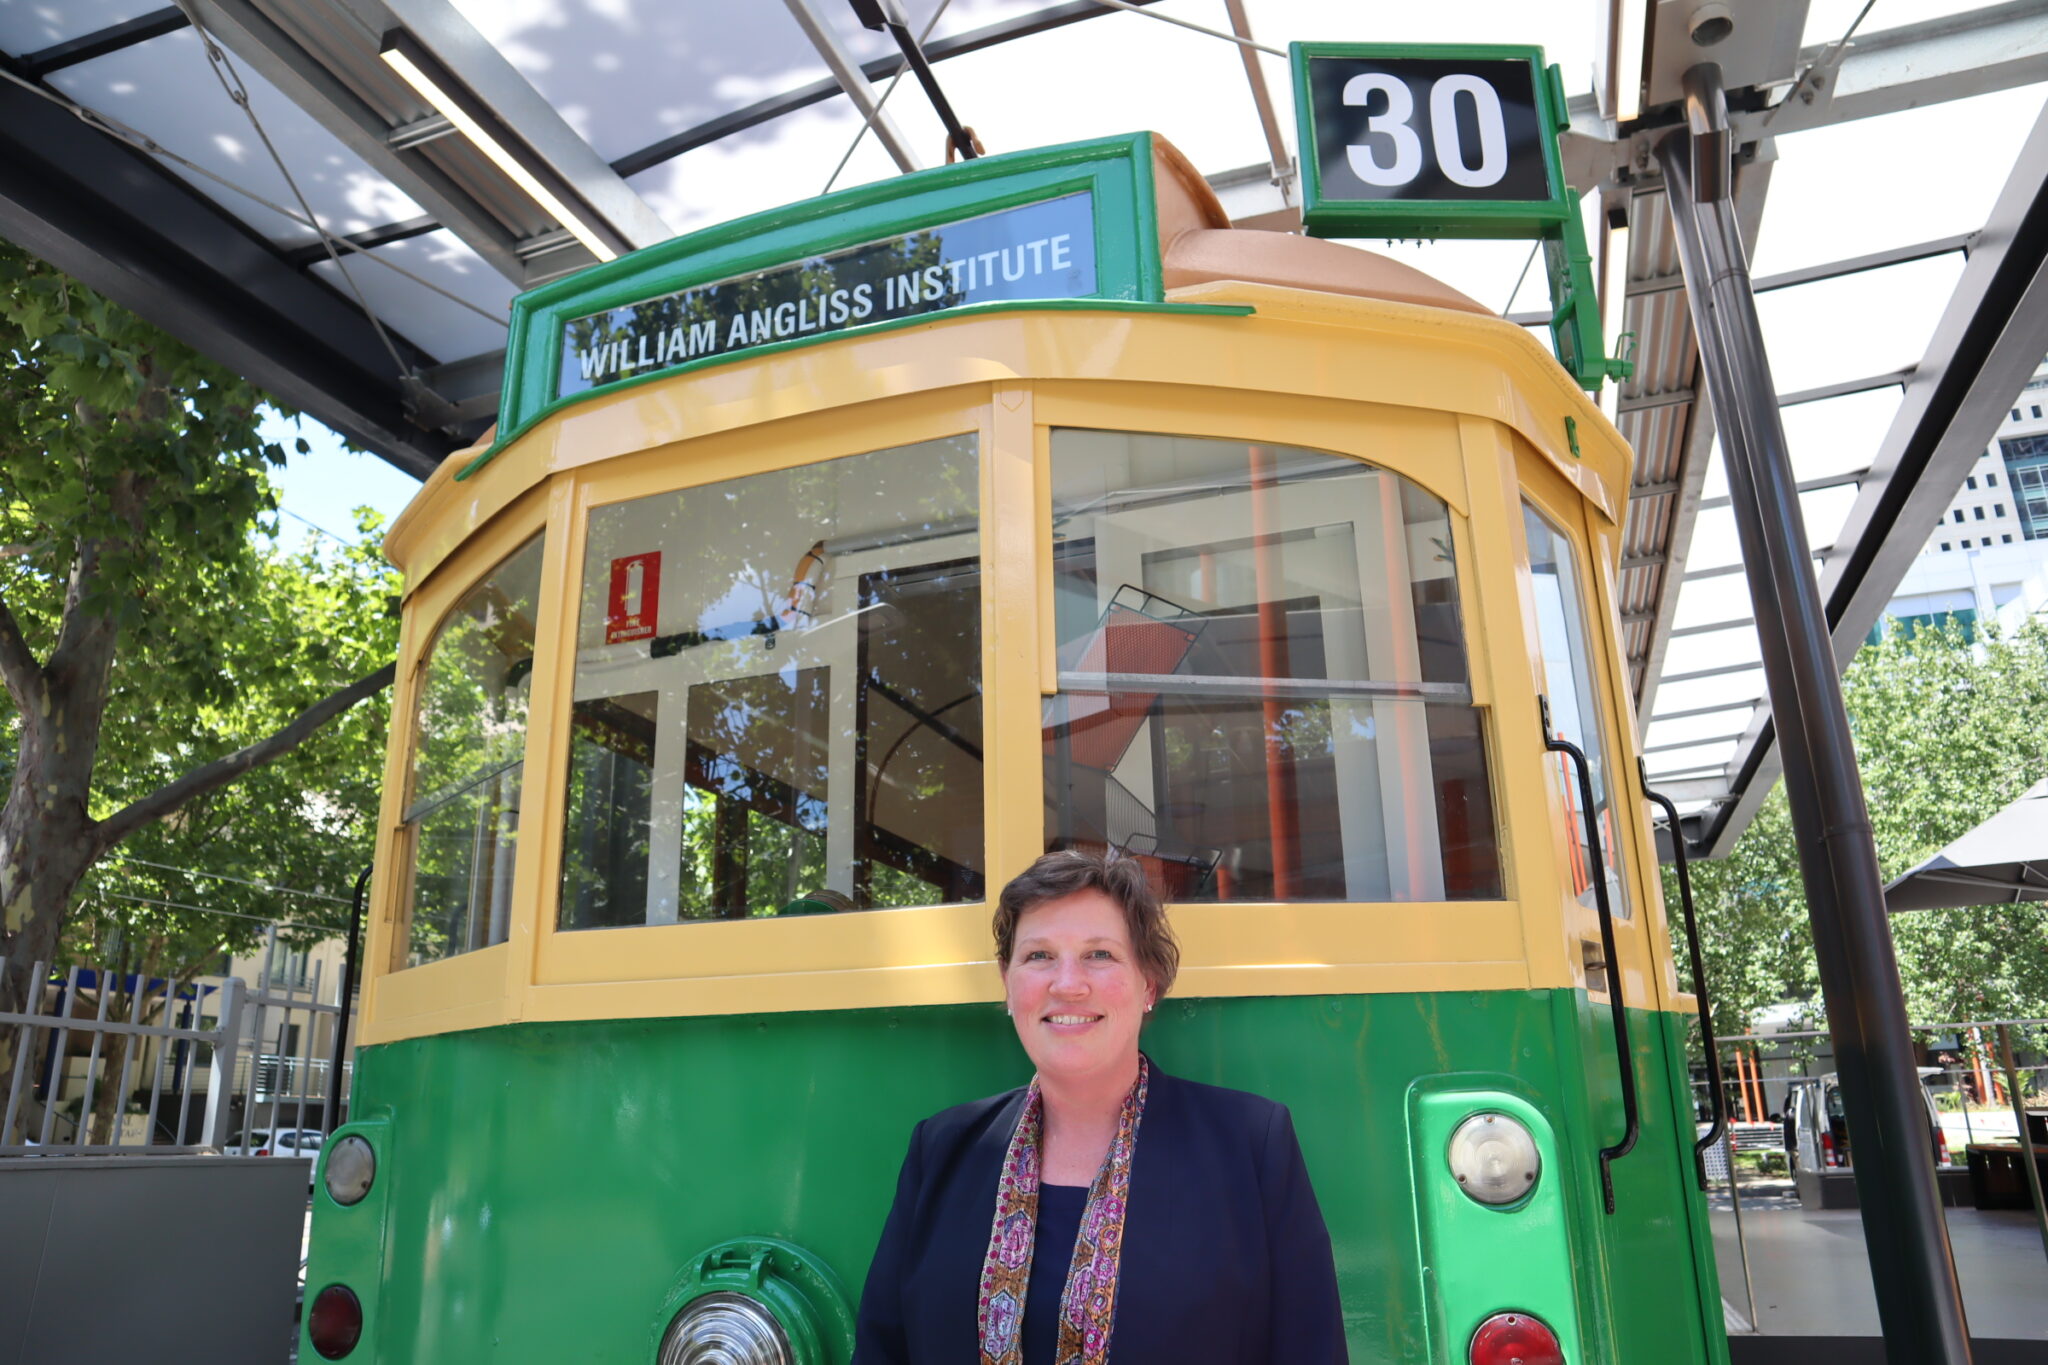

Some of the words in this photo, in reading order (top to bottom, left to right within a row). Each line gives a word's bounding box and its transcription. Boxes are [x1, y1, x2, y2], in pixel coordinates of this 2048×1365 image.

[1343, 72, 1508, 188] 30
[580, 320, 716, 379] WILLIAM
[727, 283, 873, 348] ANGLISS
[886, 233, 1072, 311] INSTITUTE
